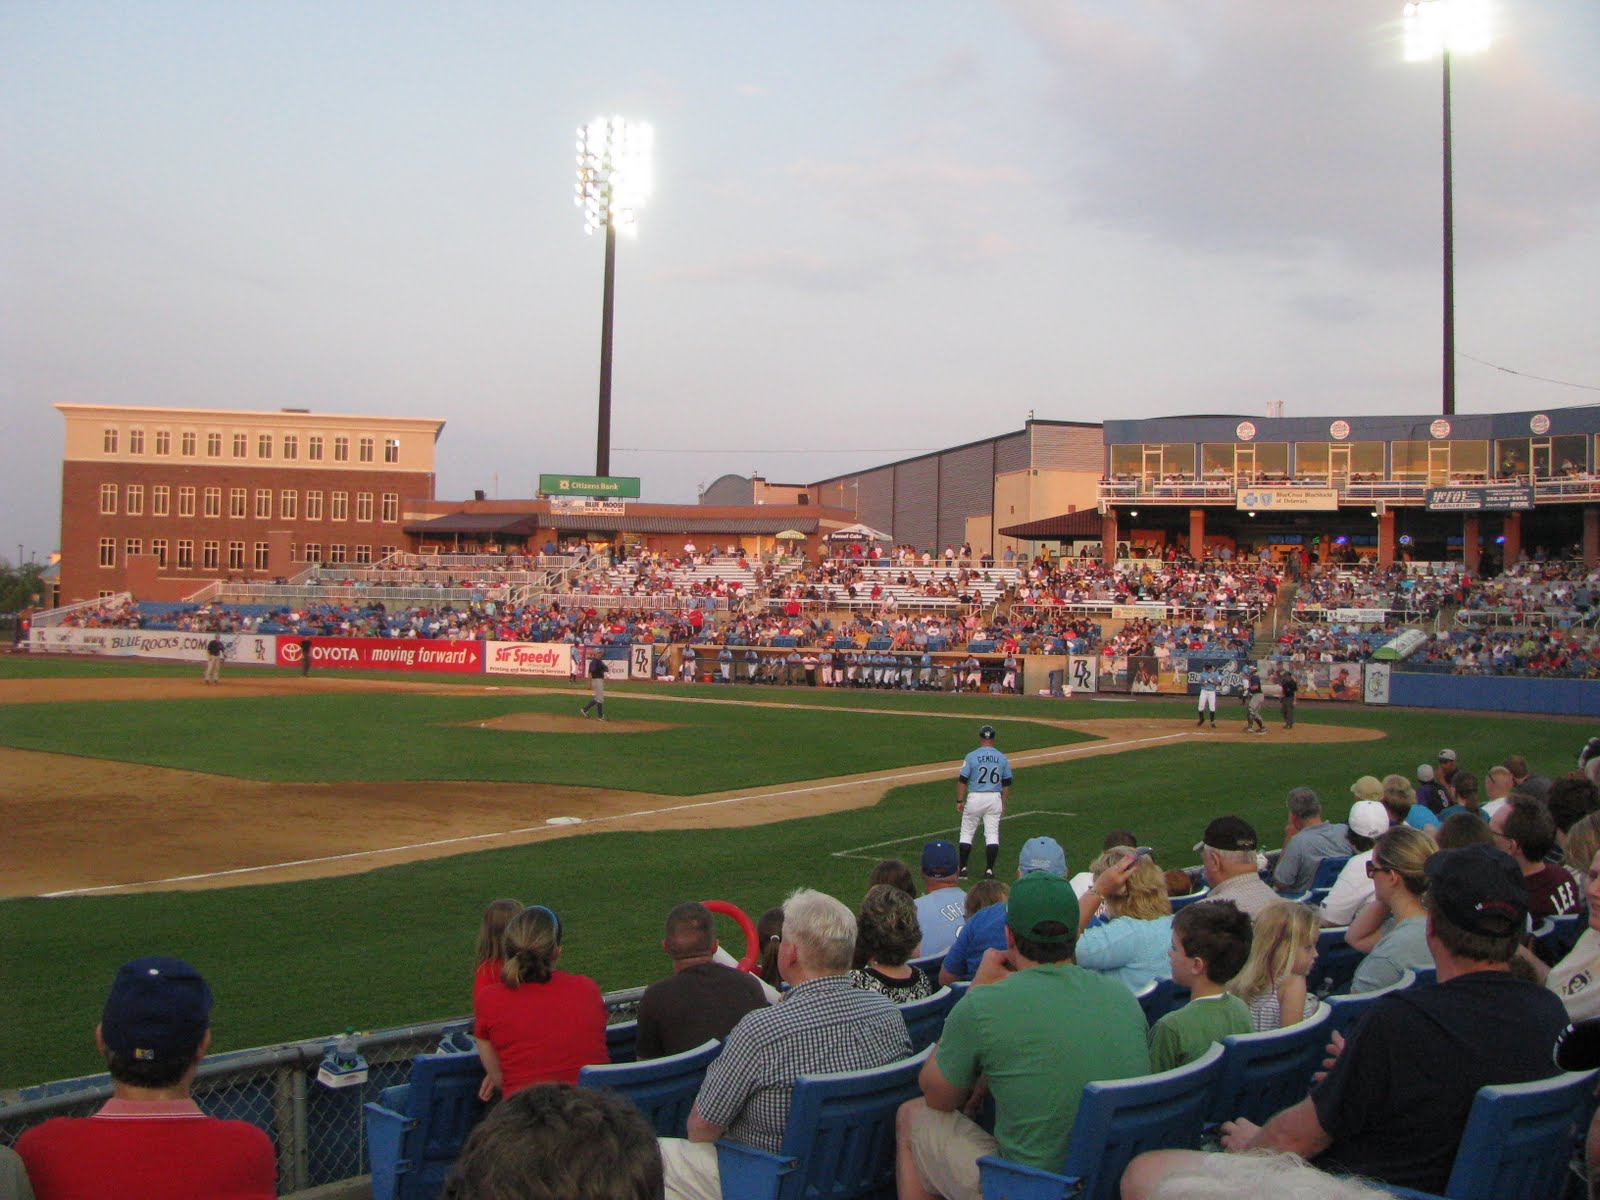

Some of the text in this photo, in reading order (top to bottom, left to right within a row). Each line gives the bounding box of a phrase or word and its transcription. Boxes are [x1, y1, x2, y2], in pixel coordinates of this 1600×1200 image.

[571, 482, 619, 491] Citizens Bank
[312, 646, 468, 666] OYOTA moving forward
[495, 648, 561, 668] Sir Speedy
[977, 755, 1000, 764] GEMOLL
[978, 766, 1000, 785] 26
[1549, 881, 1576, 916] LEE
